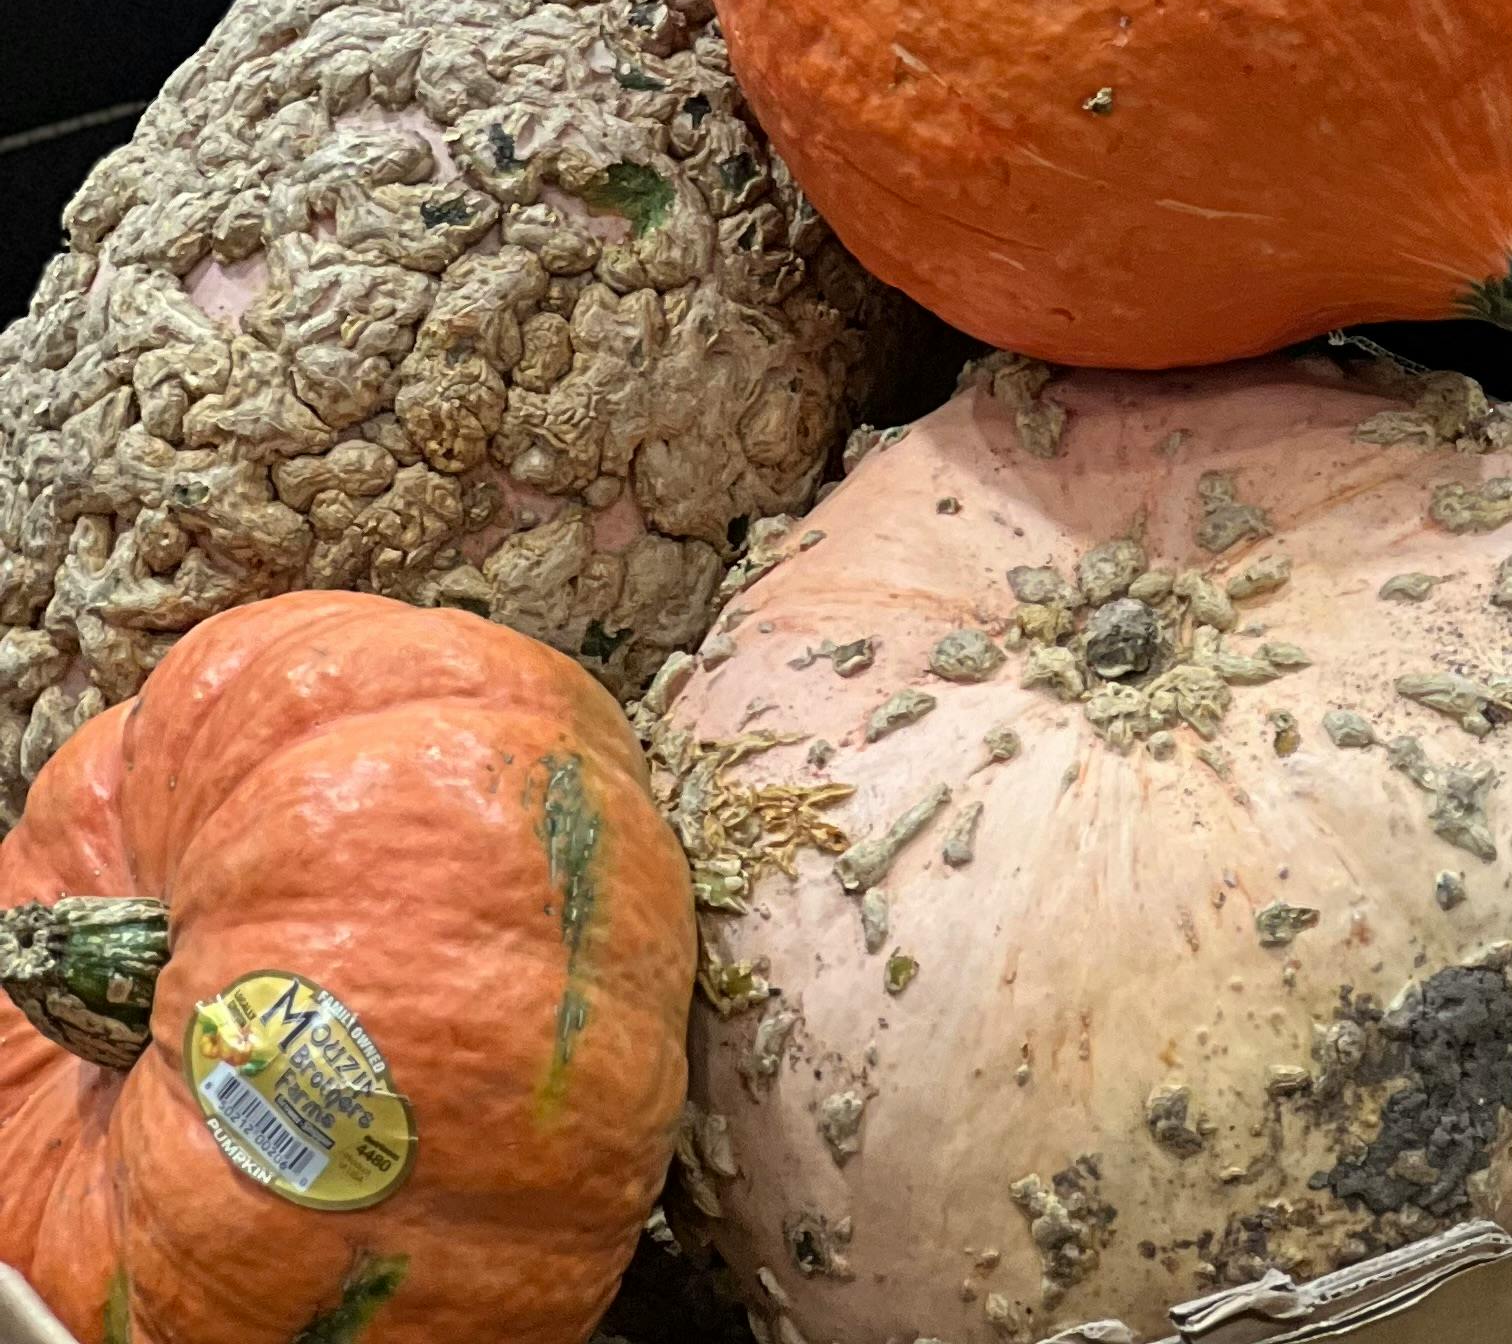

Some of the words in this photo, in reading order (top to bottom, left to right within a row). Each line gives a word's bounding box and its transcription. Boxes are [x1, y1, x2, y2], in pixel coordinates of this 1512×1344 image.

[351, 1026, 386, 1073] OWNED
[207, 1118, 273, 1184] PUMPKIN
[356, 1144, 391, 1172] 4480
